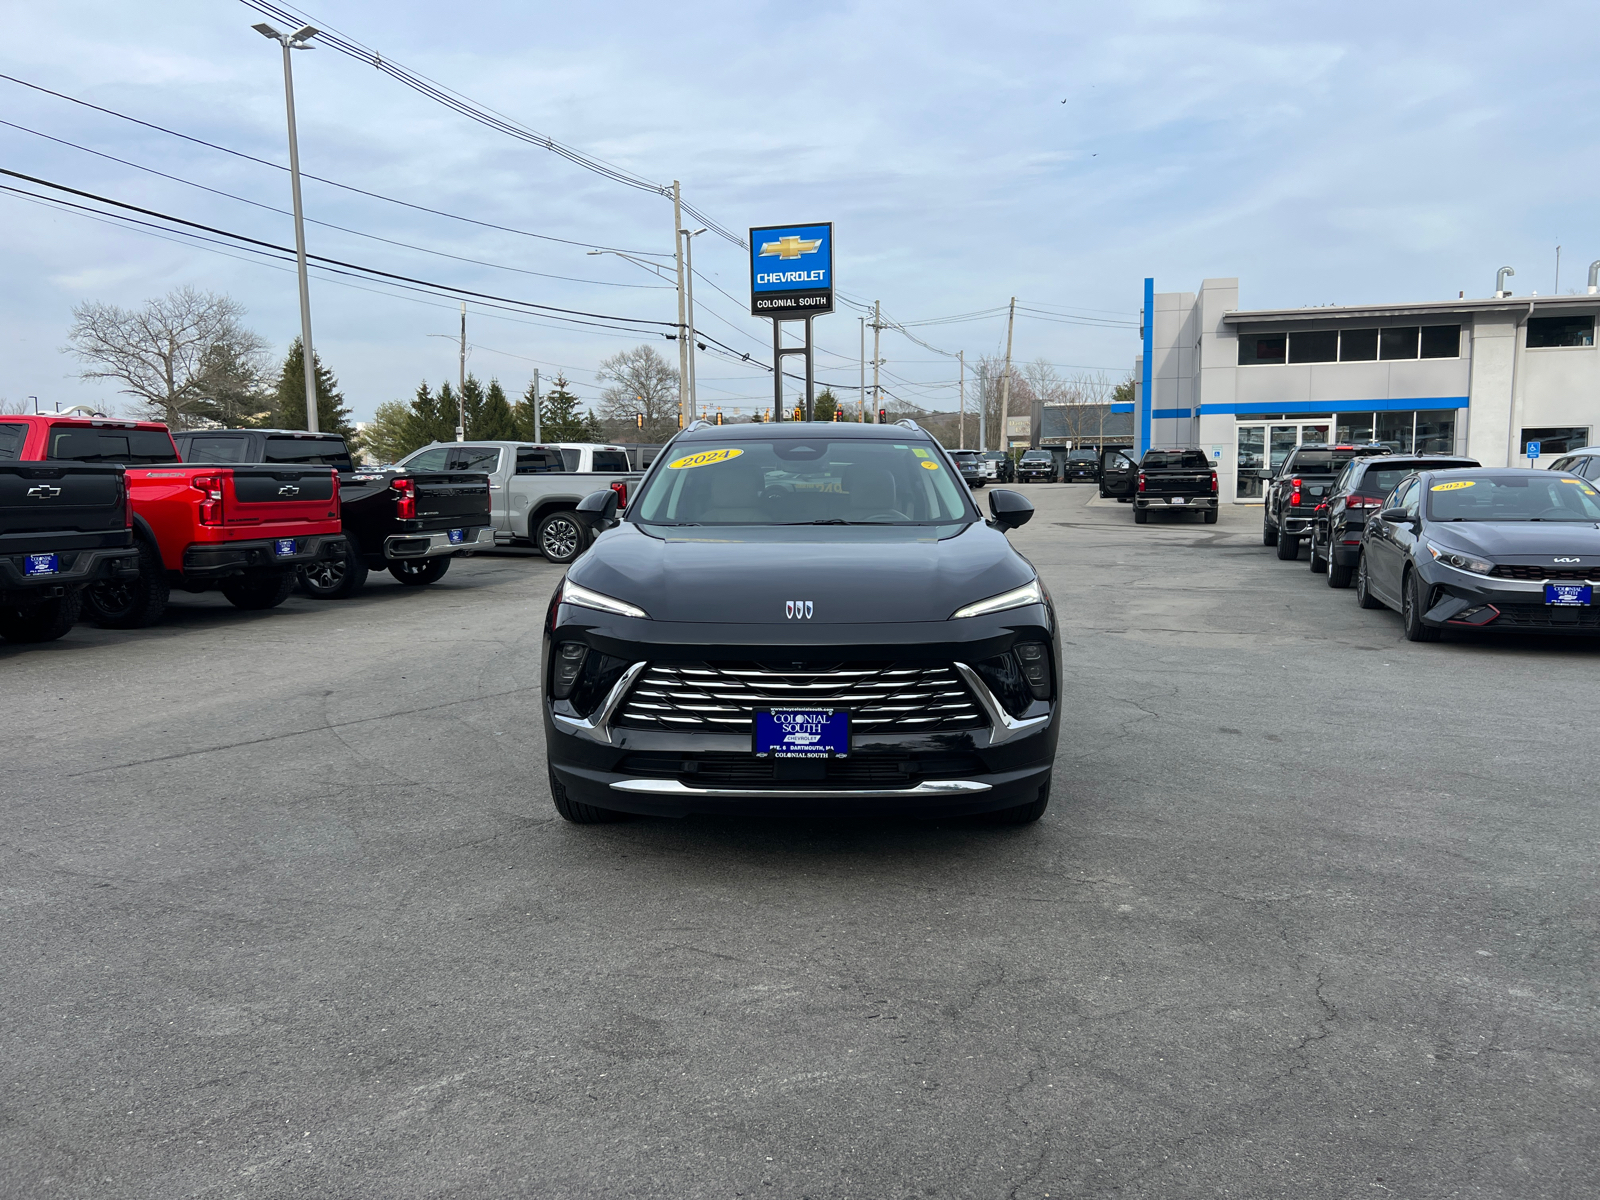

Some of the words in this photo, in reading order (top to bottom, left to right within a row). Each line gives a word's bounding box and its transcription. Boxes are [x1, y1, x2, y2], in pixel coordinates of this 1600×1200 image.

[757, 270, 825, 284] CHEVROLET
[757, 298, 797, 308] COLONIAL
[798, 296, 827, 306] SOUTH
[681, 450, 731, 467] 2024
[773, 714, 831, 724] COLONIAL
[782, 723, 822, 733] SOUTH
